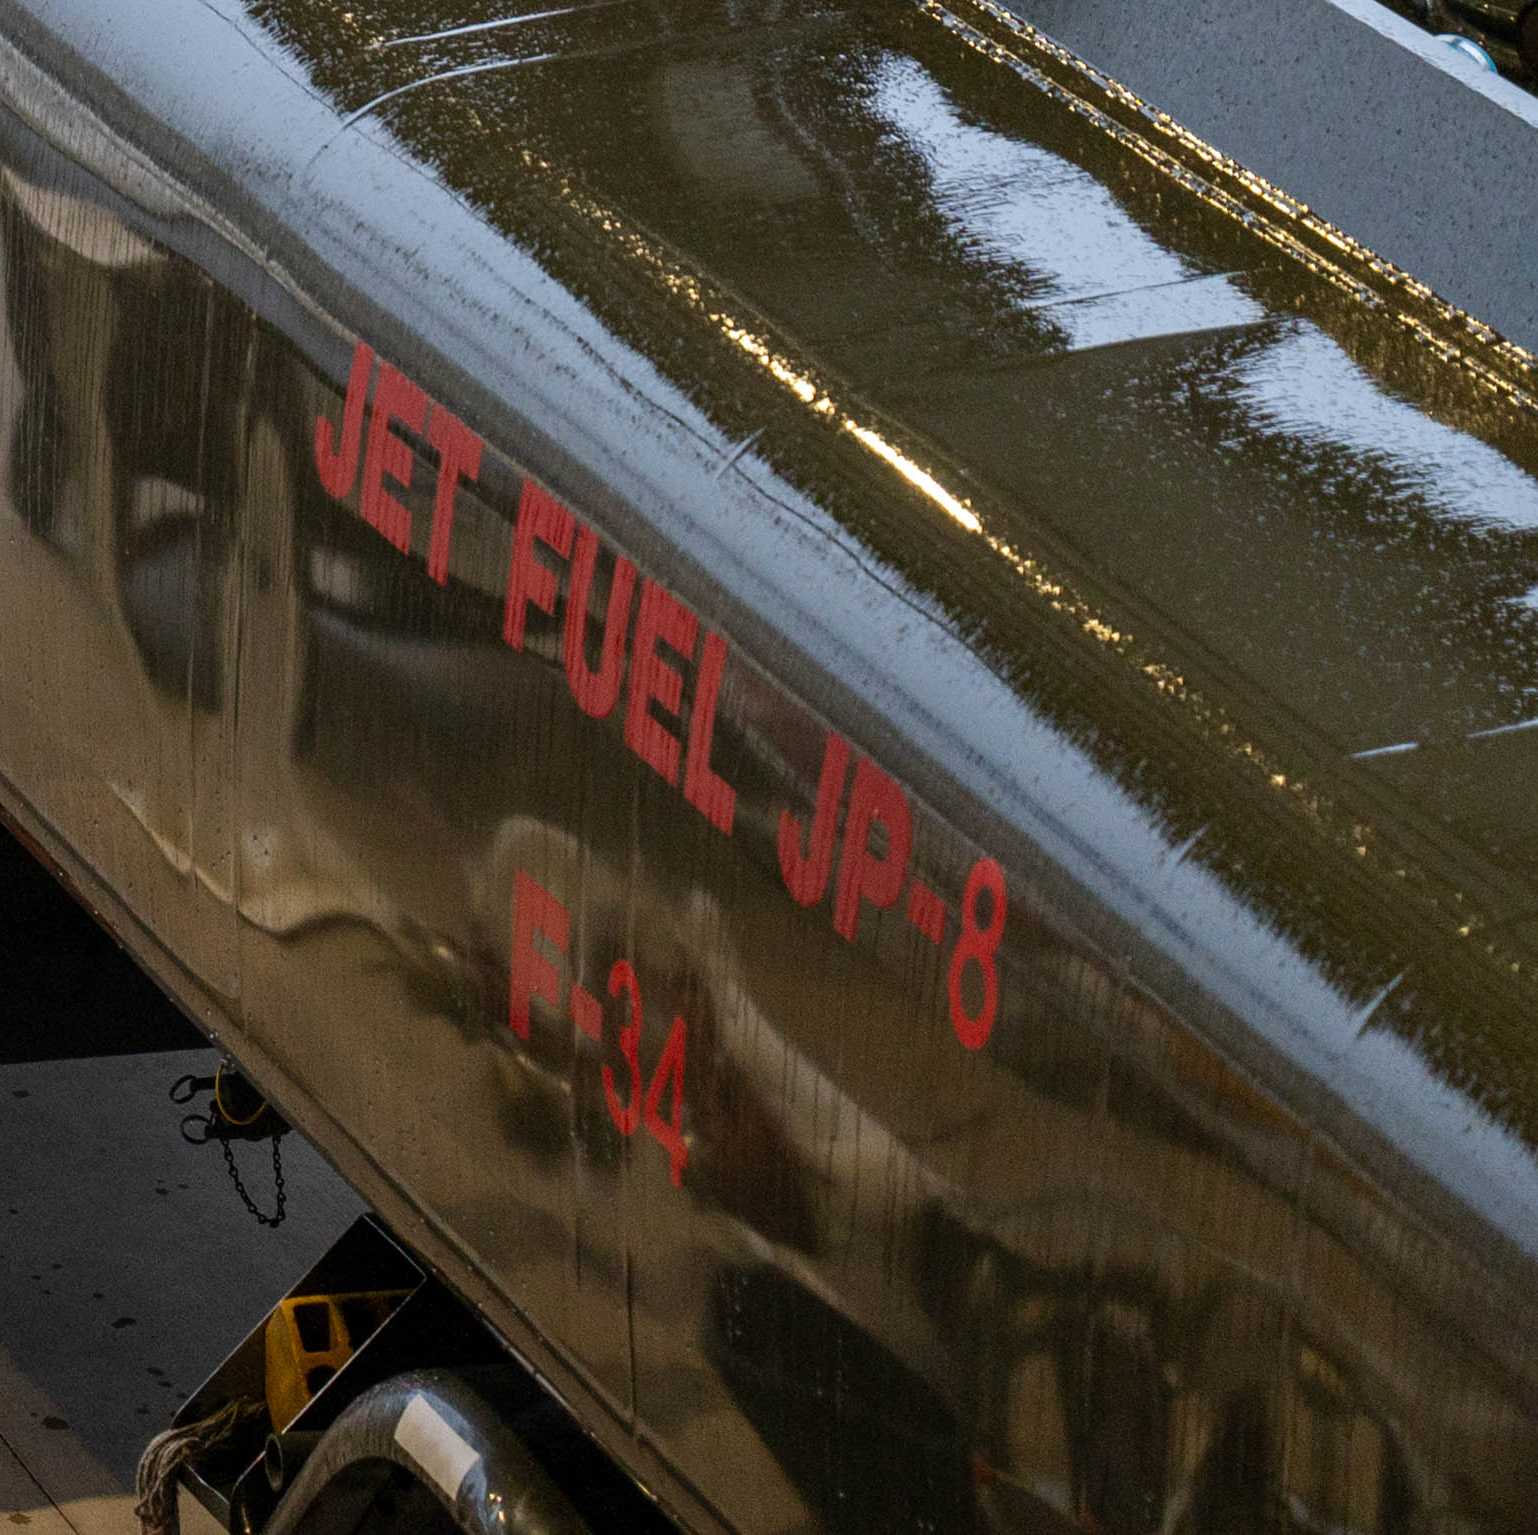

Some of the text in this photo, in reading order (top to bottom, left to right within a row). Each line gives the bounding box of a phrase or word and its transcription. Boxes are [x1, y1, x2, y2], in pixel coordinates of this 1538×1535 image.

[315, 338, 1007, 1050] JET FUEL JP-8
[509, 867, 690, 1187] F-34
